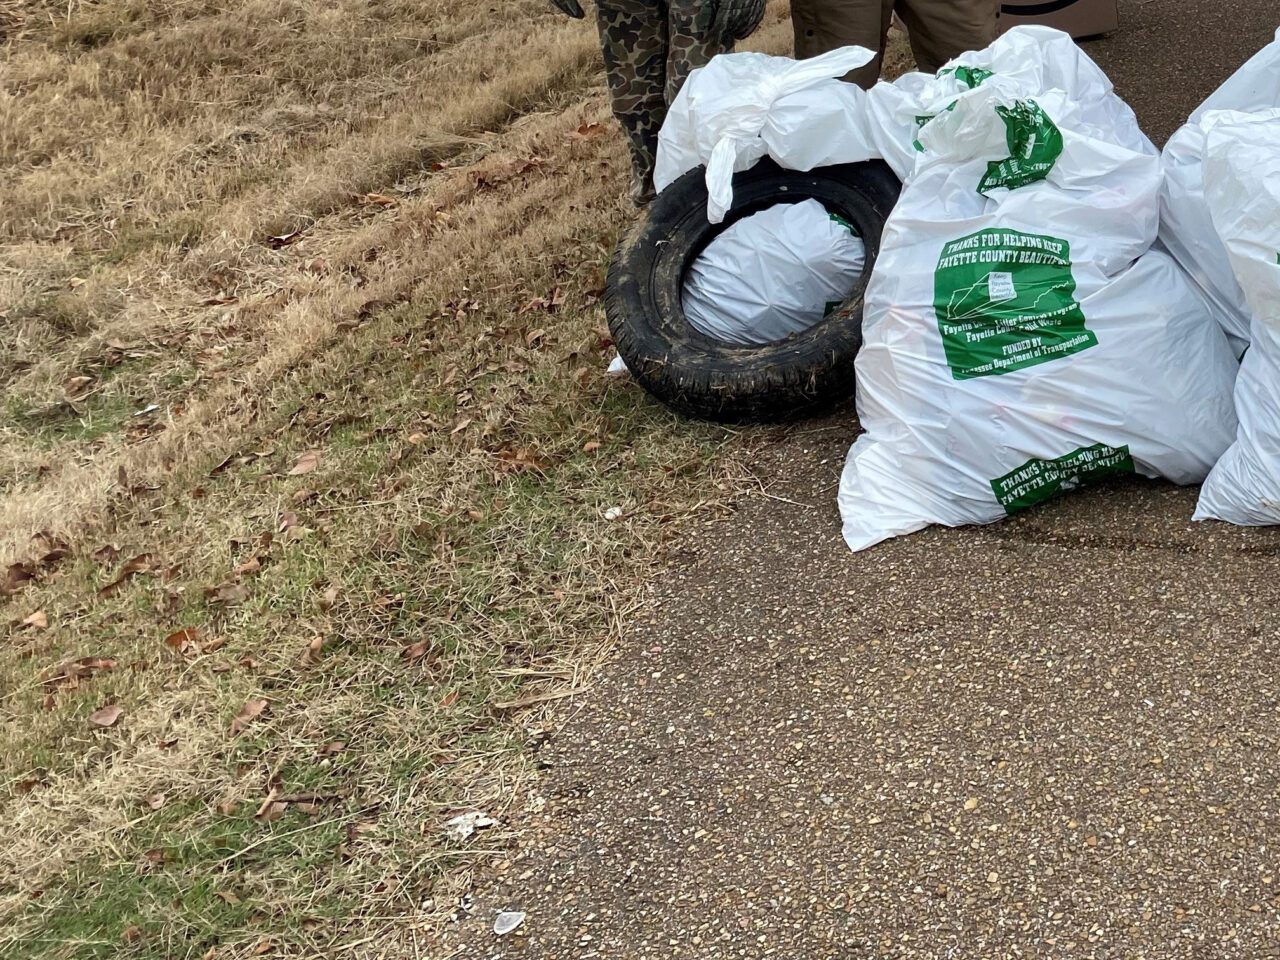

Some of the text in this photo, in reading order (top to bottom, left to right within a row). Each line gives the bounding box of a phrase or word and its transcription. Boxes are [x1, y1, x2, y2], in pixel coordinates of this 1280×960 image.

[948, 233, 1062, 254] THANKS FOR HELPING KEEP
[938, 251, 977, 269] FAYETTE
[979, 250, 1018, 263] COUNTY
[943, 321, 972, 335] Fayette
[966, 329, 995, 342] Fayette
[993, 350, 1033, 368] Department
[1034, 346, 1042, 357] of
[1042, 334, 1090, 354] Transportation
[1002, 337, 1042, 355] FUNDED BY
[1000, 463, 1040, 492] THANKS
[1060, 450, 1099, 469] HELPING
[1001, 477, 1045, 506] FAYETTE
